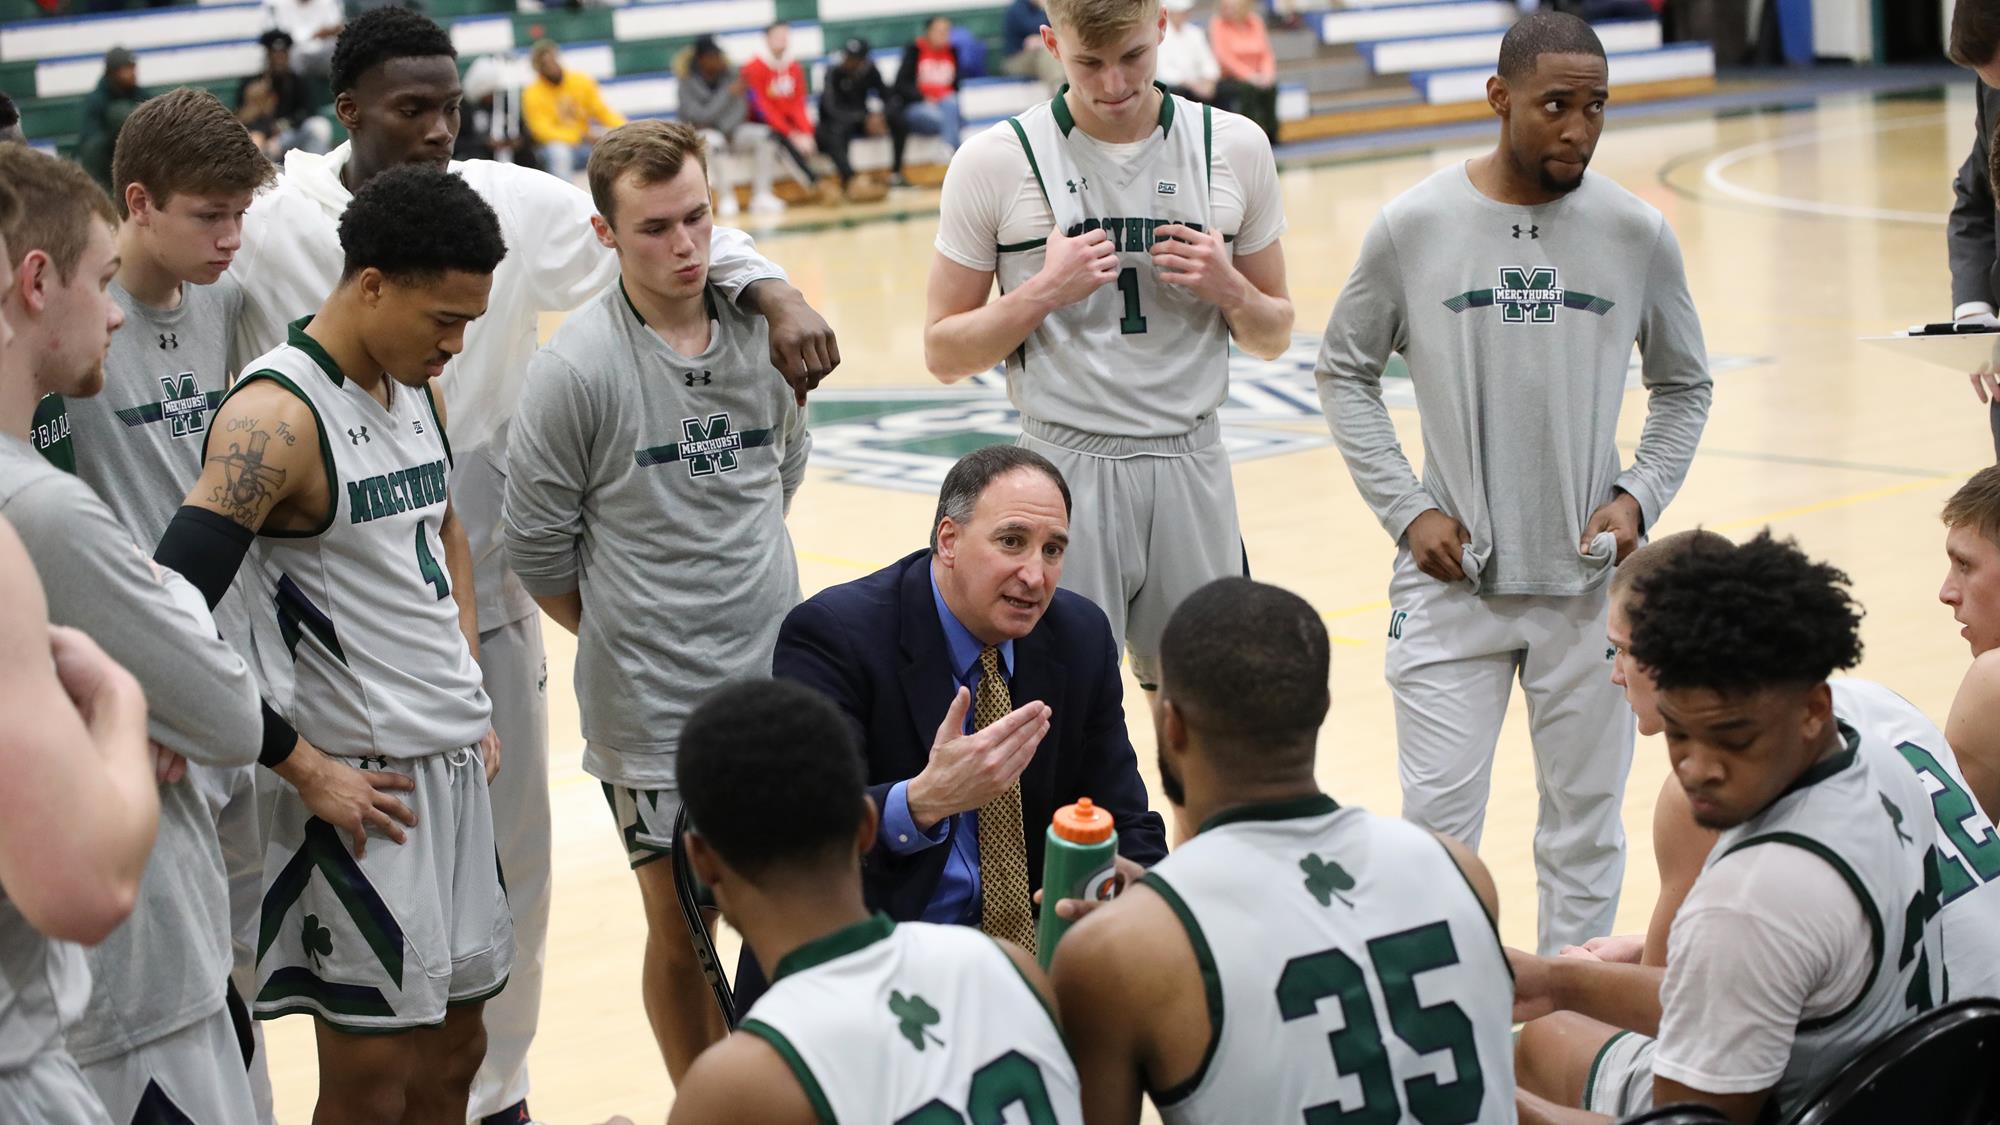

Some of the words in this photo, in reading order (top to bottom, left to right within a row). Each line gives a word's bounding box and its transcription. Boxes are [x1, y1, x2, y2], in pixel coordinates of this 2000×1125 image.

[1117, 267, 1147, 335] 1
[1496, 289, 1562, 301] MERCYHURST
[226, 416, 259, 432] Only
[275, 421, 296, 446] The
[681, 434, 738, 455] MERCYHURST
[347, 458, 447, 524] MERCYHURS
[415, 519, 450, 601] 4
[1275, 919, 1486, 1125] 35
